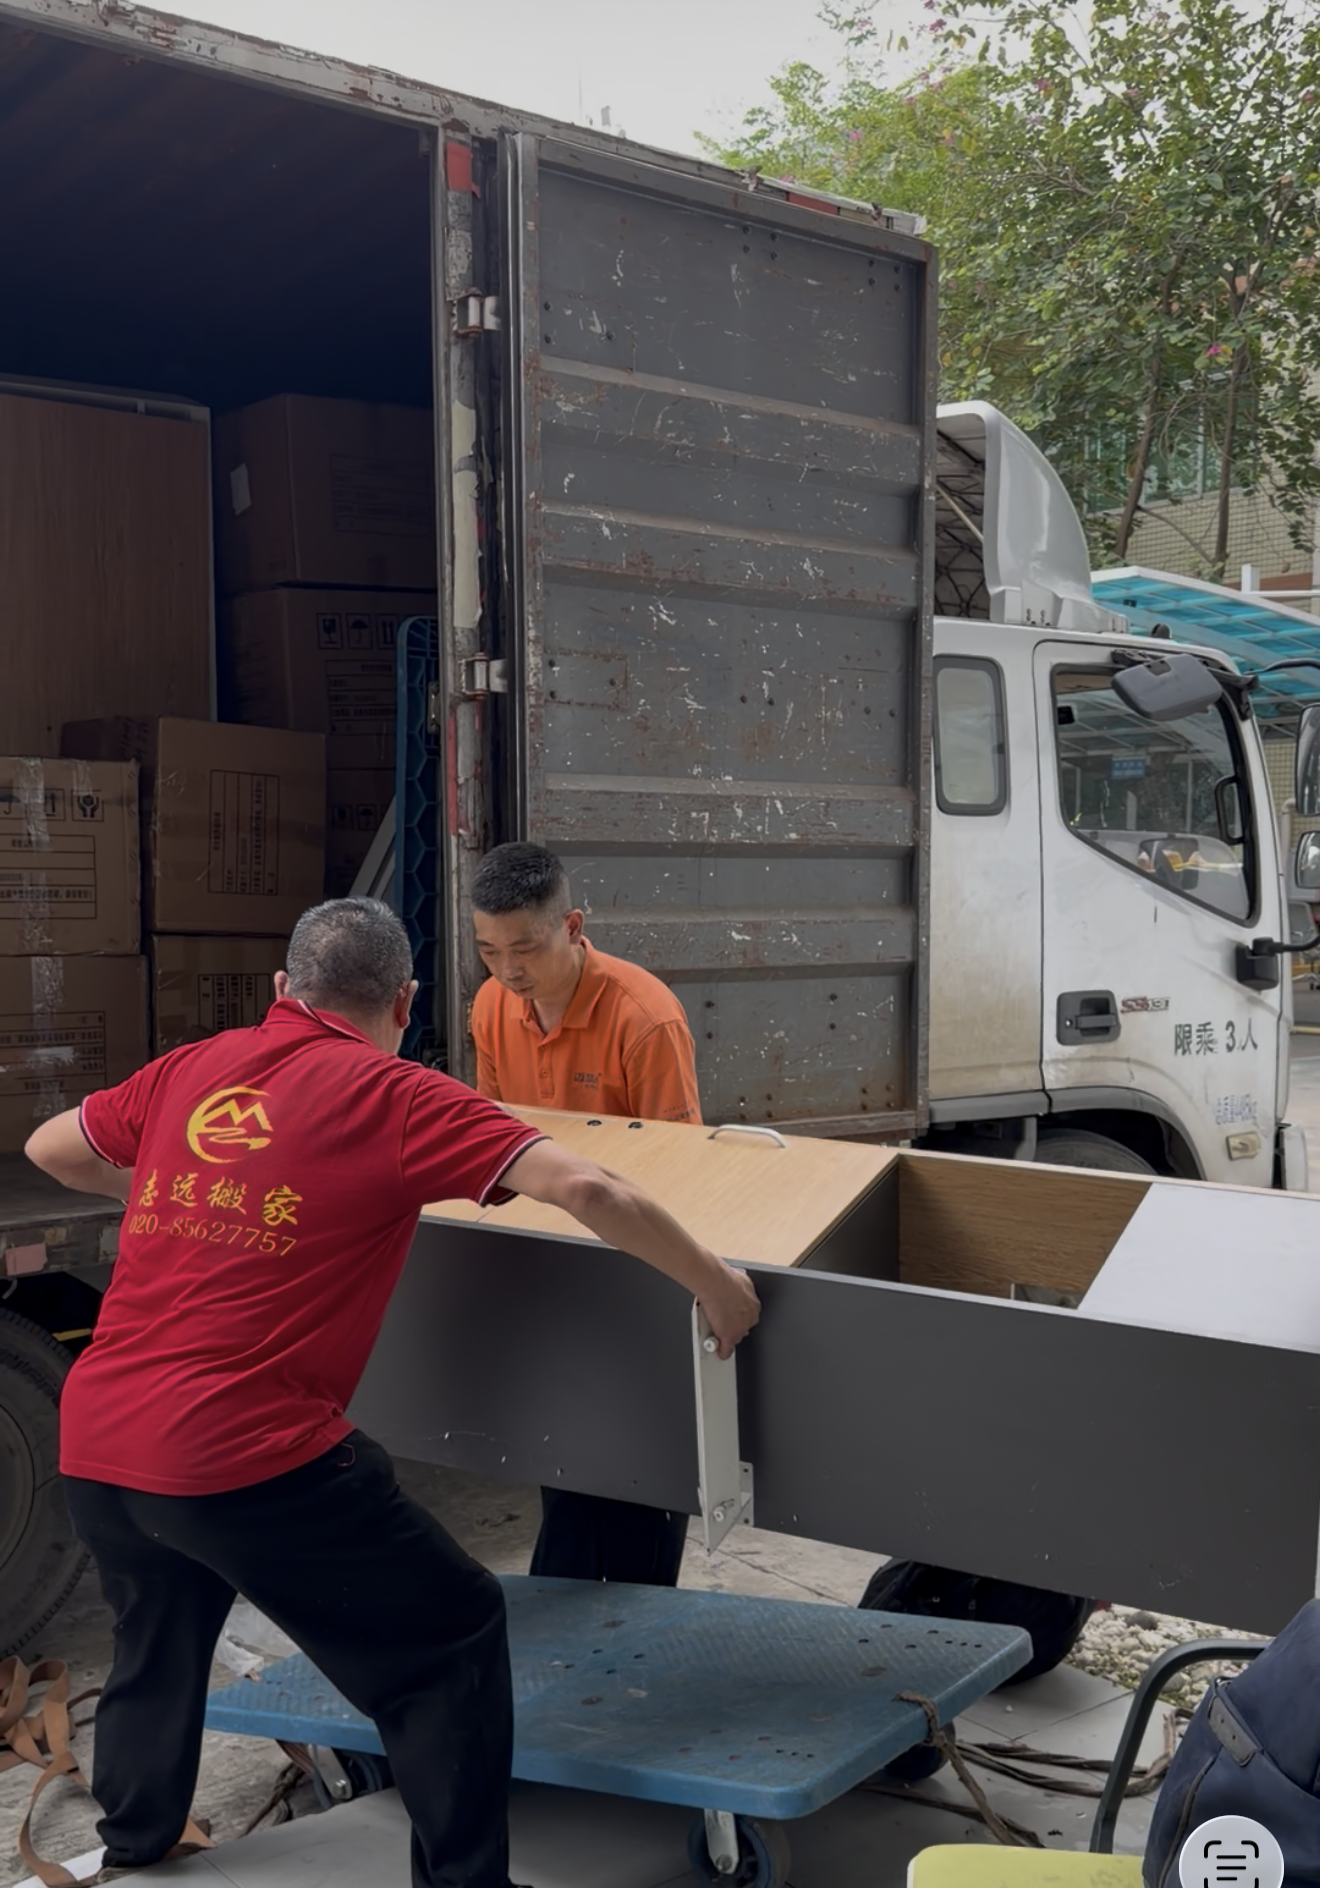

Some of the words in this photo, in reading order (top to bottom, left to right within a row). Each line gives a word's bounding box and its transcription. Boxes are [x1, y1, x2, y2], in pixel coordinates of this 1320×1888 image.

[139, 1169, 303, 1226] 志远搬家
[129, 1213, 297, 1256] 020-85627757
